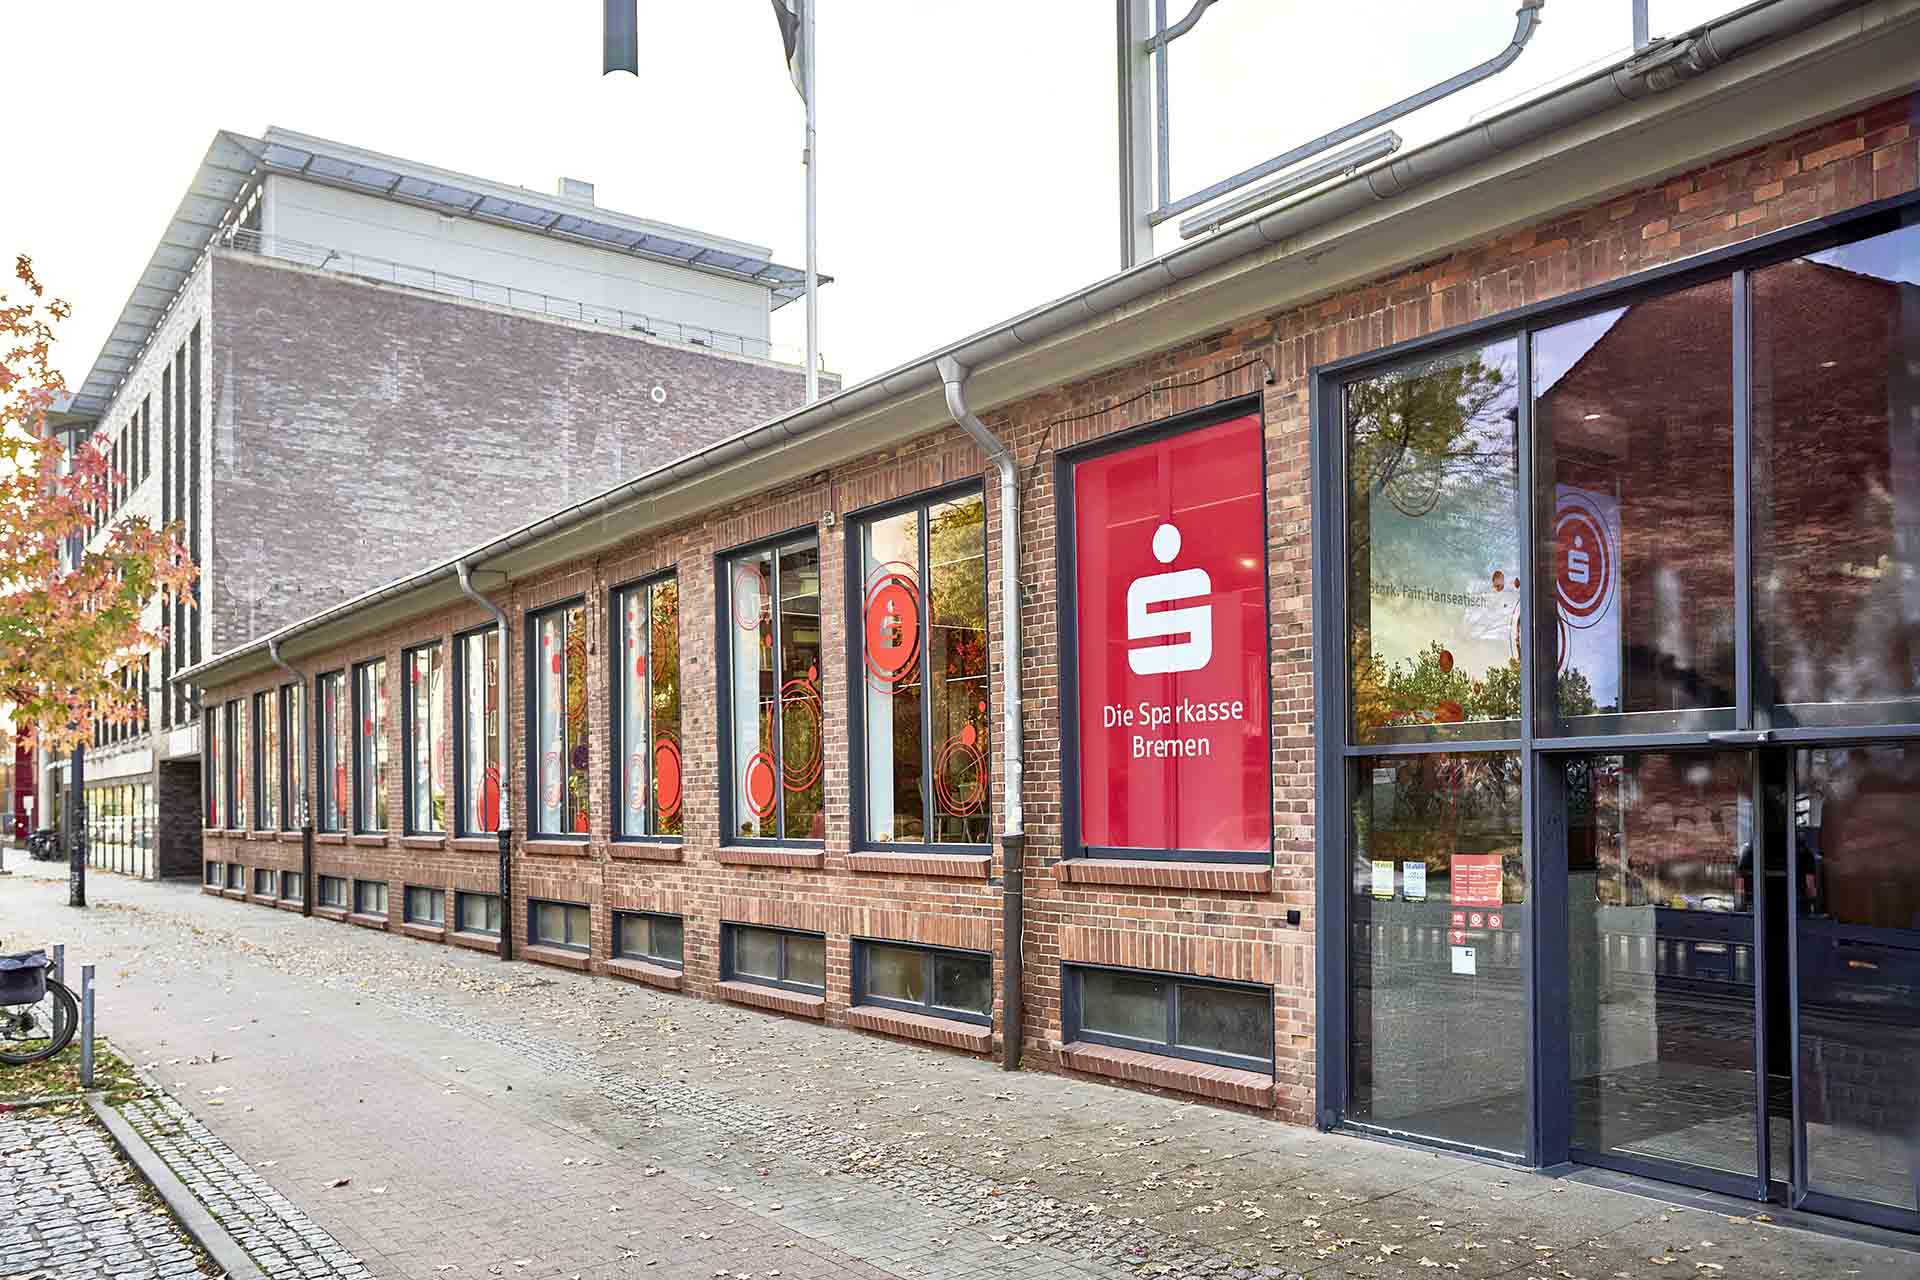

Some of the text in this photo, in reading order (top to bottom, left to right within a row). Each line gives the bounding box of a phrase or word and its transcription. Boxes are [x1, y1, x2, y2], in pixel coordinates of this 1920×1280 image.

[1103, 697, 1244, 731] Die Sparkasse
[1132, 735, 1211, 759] Bremen
